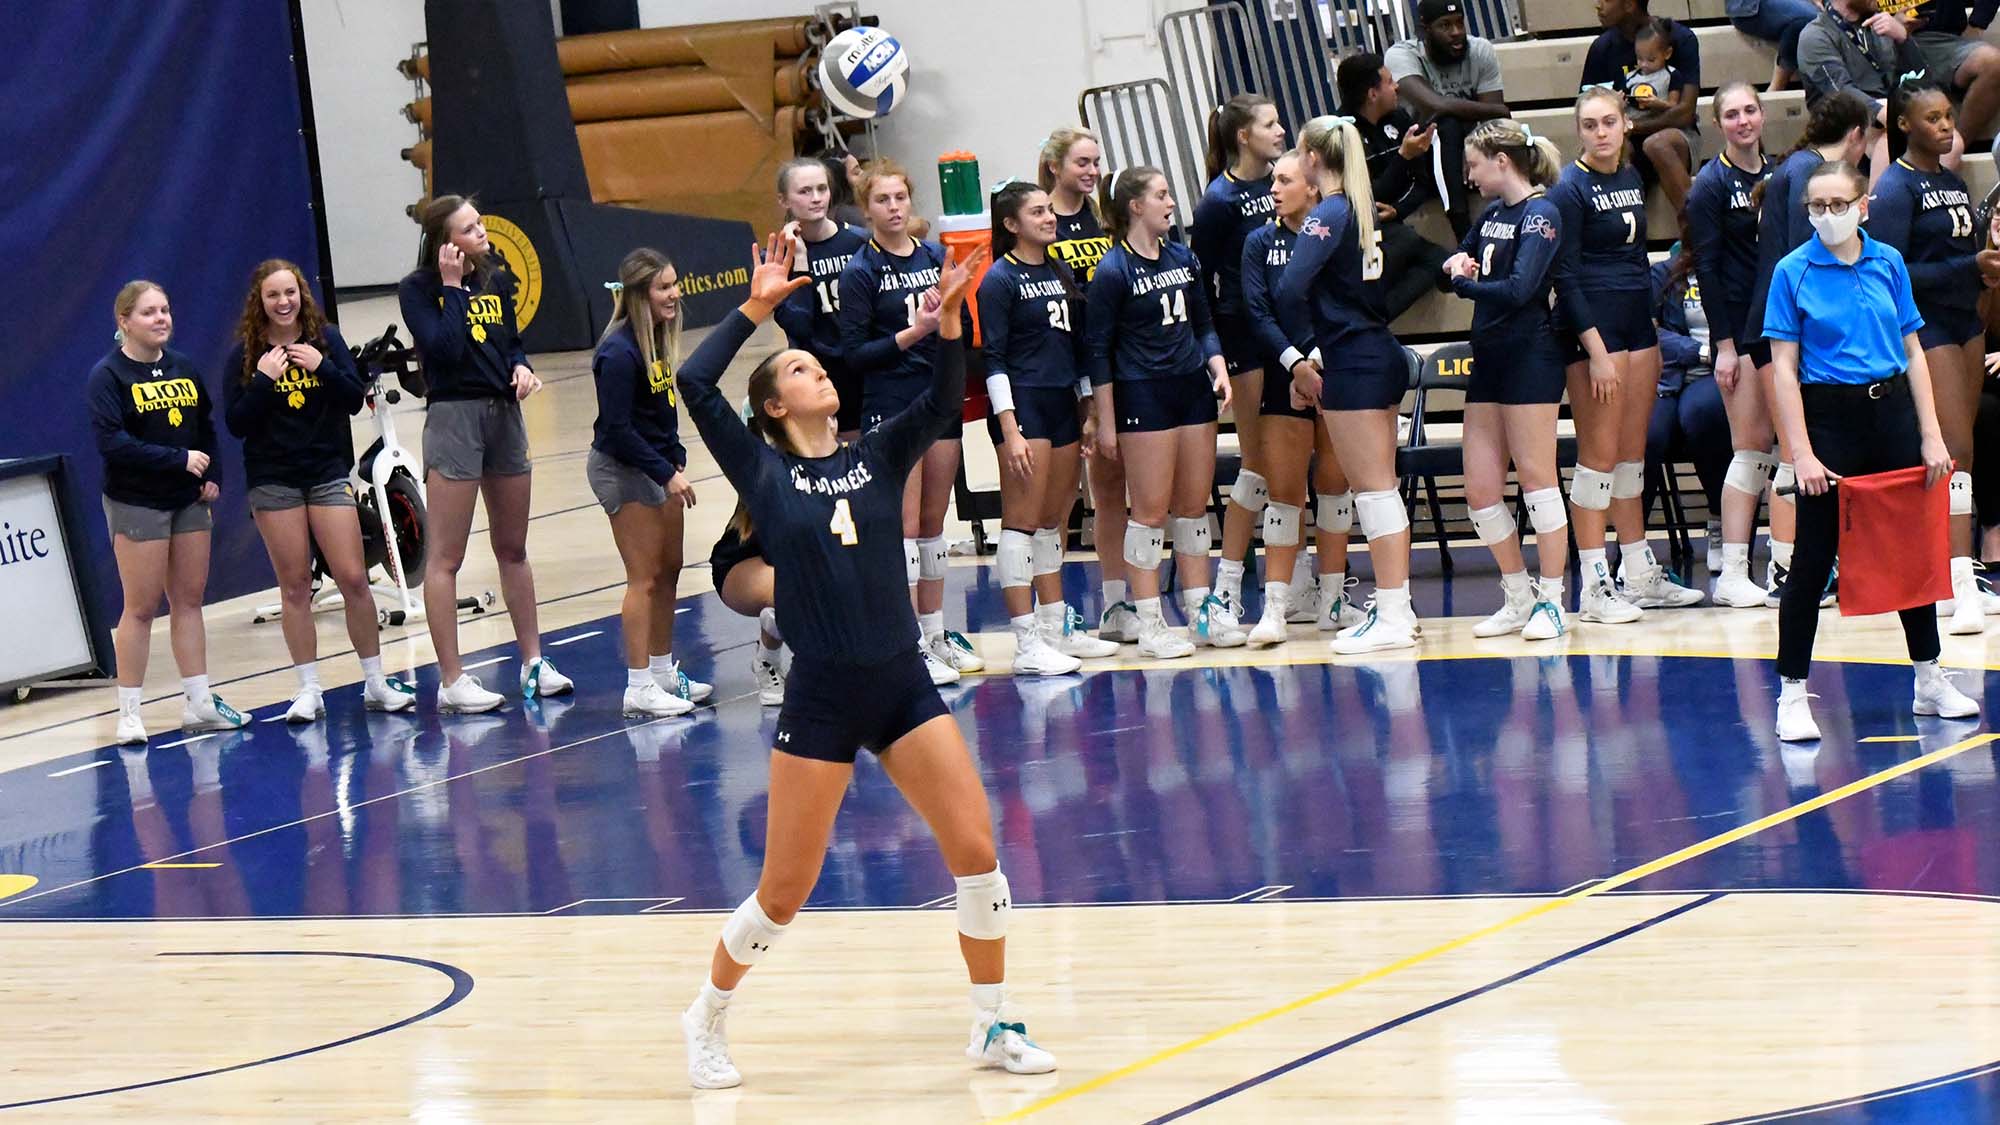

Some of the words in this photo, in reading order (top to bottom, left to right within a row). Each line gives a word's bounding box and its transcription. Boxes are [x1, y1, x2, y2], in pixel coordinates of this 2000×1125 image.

[1621, 211, 1636, 244] 7
[1947, 206, 1972, 237] 13
[1054, 241, 1110, 261] LION
[1482, 243, 1495, 276] 8
[677, 267, 748, 297] etics.com
[1047, 299, 1071, 332] 21
[1160, 289, 1187, 326] 14
[1437, 357, 1473, 376] LIO
[138, 382, 193, 402] LION
[829, 498, 859, 546] 4
[680, 677, 689, 700] DGT
